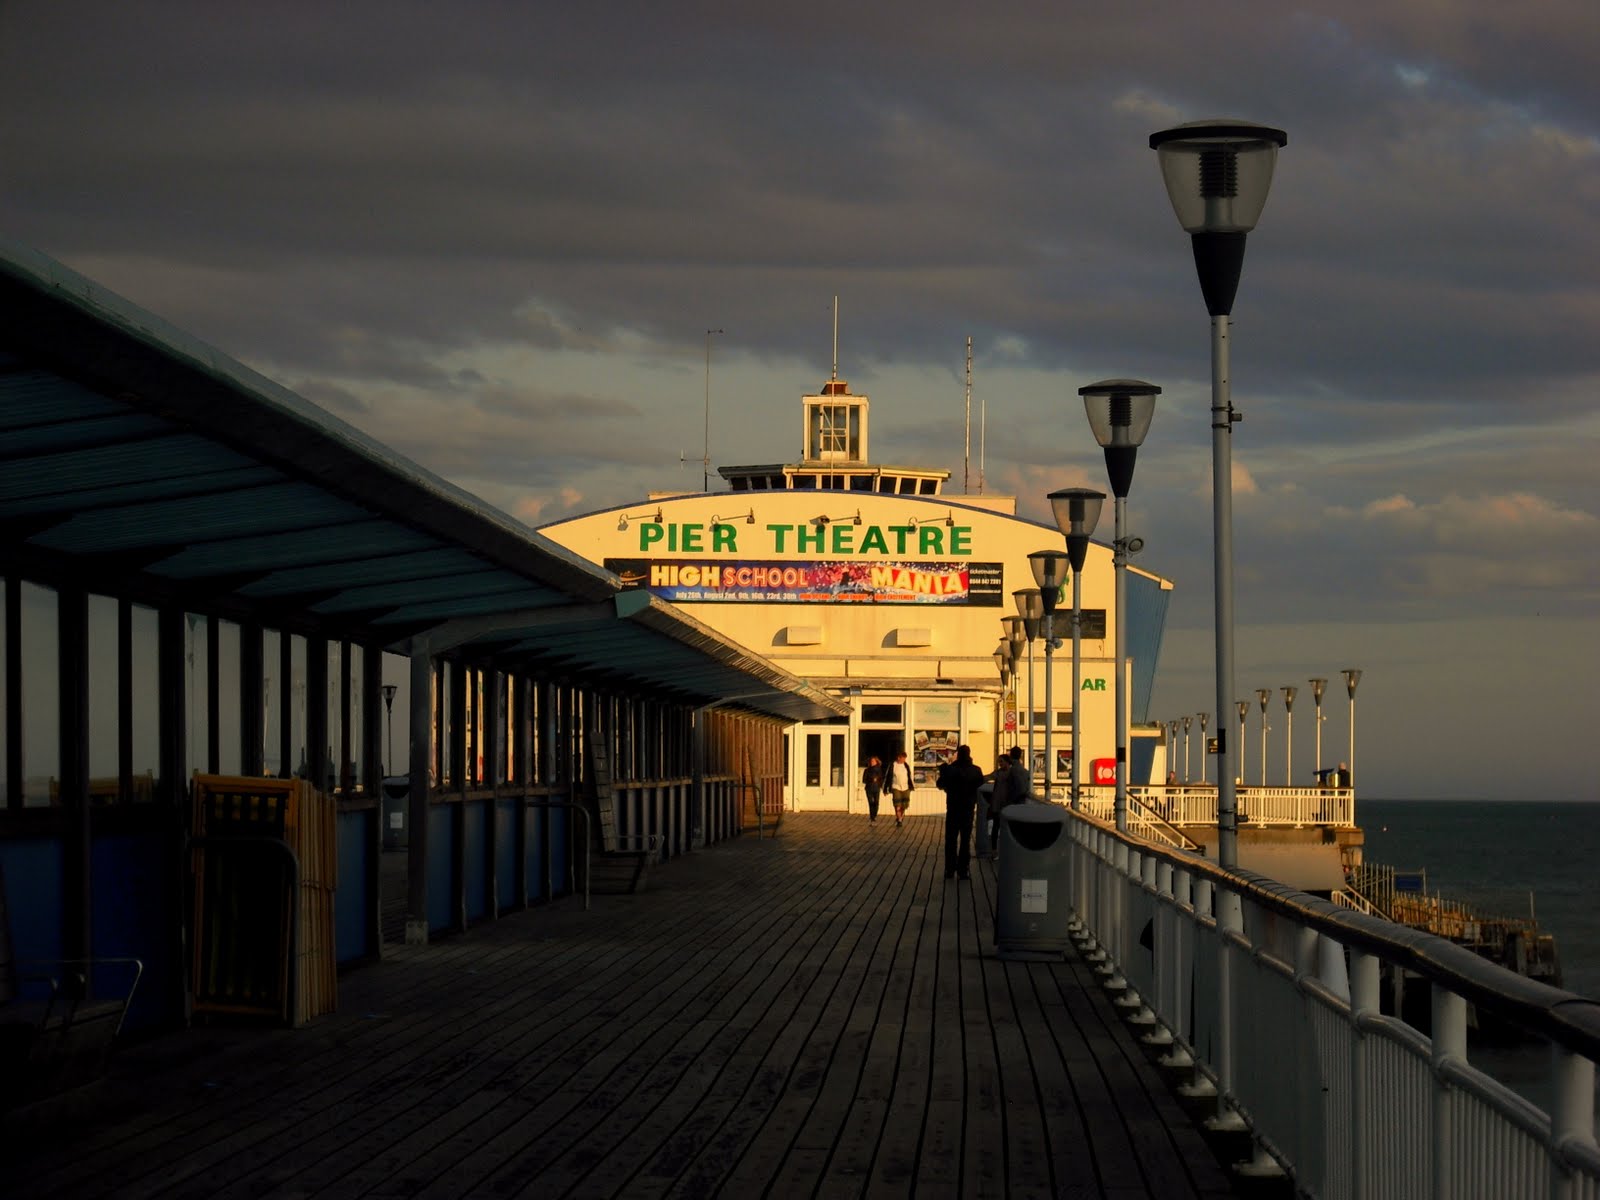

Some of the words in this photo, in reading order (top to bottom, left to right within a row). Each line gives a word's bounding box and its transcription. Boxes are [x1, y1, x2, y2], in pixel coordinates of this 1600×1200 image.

[639, 523, 738, 552] PIER
[766, 524, 973, 555] THEATRE
[650, 565, 720, 587] HIGH
[722, 567, 809, 588] SCHOOL
[870, 566, 964, 595] MANIA
